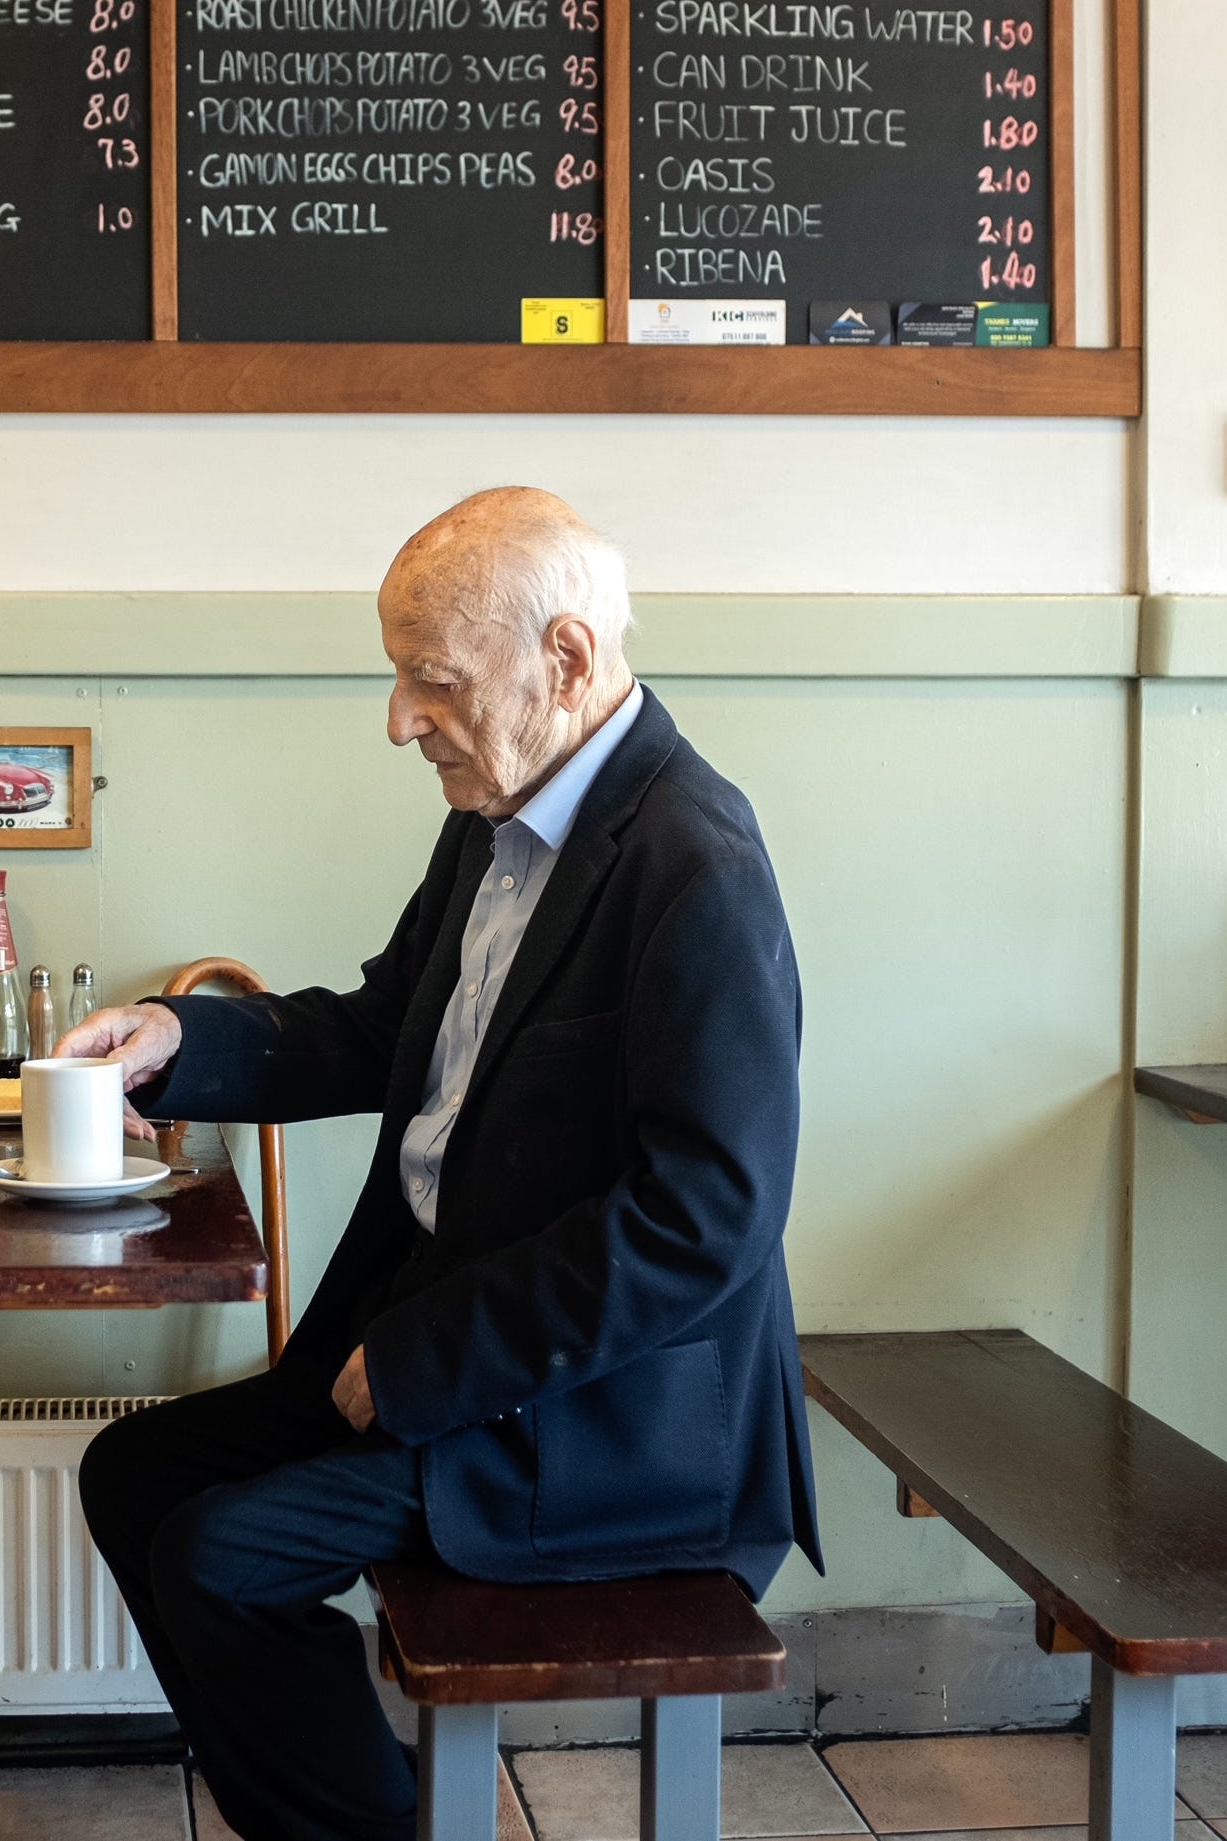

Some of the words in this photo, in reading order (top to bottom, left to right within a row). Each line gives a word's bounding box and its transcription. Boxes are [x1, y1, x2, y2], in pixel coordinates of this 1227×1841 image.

[89, 0, 135, 33] 8.0
[196, 0, 262, 31] ROAST
[561, 0, 599, 32] 9.5
[656, 0, 854, 40] SPARKLING
[865, 8, 974, 45] WATER
[983, 19, 1033, 51] 1.50
[86, 45, 131, 81] 8.0
[357, 51, 451, 86] POTATO
[653, 51, 726, 90] CAN
[741, 55, 872, 92] DRINK
[985, 68, 1036, 100] 1.40
[83, 93, 129, 130] 8.0
[199, 97, 276, 136] PORK
[357, 98, 448, 133] POTATO
[478, 100, 541, 130] VEG
[559, 98, 598, 134] 9.5
[654, 101, 775, 142] FRUIT
[789, 105, 907, 147] JUICE
[983, 116, 1038, 150] 1.80
[199, 152, 297, 188] GAMON
[304, 152, 357, 183] EGGS
[362, 152, 451, 185] CHIPS
[459, 151, 536, 189] PEAS
[555, 153, 597, 190] 8.0
[657, 156, 775, 193] OASIS
[978, 166, 1030, 194] 2.10
[98, 204, 133, 232] 1.0
[201, 205, 277, 237] MIX
[291, 201, 388, 234] GRILL
[659, 202, 823, 238] LUCOZADE
[978, 216, 1033, 247] 2.10
[656, 248, 786, 286] RIBENA
[980, 250, 1036, 290] 1.40
[556, 316, 568, 334] S
